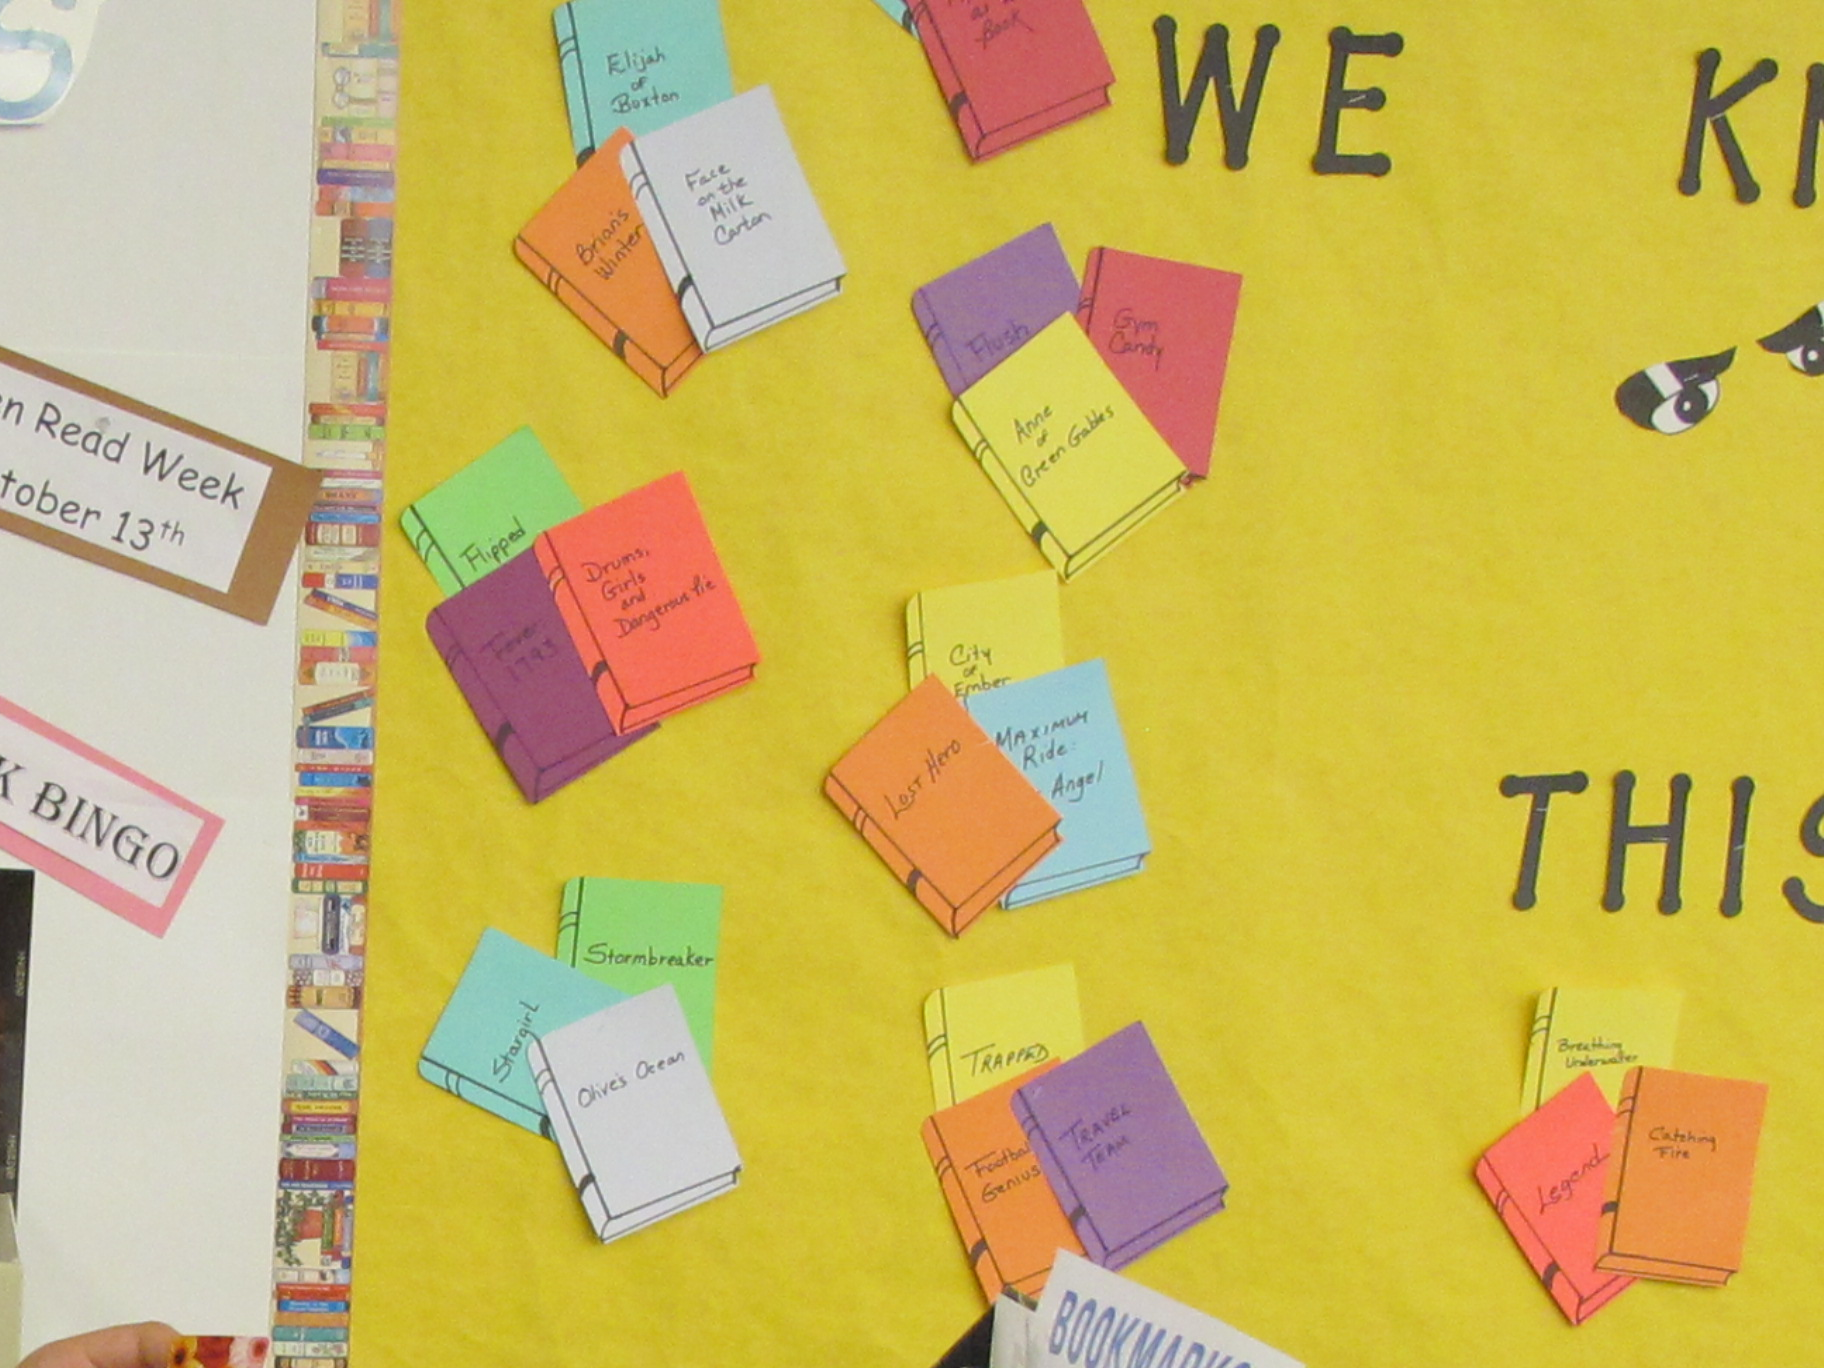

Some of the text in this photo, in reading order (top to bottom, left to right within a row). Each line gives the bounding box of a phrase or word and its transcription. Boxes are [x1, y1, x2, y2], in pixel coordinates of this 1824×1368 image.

[606, 46, 666, 76] Elijah
[630, 76, 647, 92] of
[1154, 15, 1404, 176] WE
[685, 164, 731, 191] Face
[697, 175, 747, 206] on the
[709, 195, 754, 221] Milk
[713, 211, 772, 246] Carton
[594, 223, 644, 280] Winter
[1113, 308, 1159, 336] Gym
[963, 317, 1031, 364] Flush
[1108, 330, 1163, 371] Candy
[1012, 405, 1054, 444] Anne
[34, 401, 132, 464] Read
[142, 441, 245, 510] Week
[1019, 446, 1066, 488] Green
[110, 510, 186, 552] 13th
[459, 517, 527, 573] Flipped
[601, 569, 646, 600] Girls
[621, 587, 645, 610] and
[950, 644, 992, 665] City
[954, 676, 1011, 699] Ember
[1051, 760, 1102, 803] Angel
[29, 781, 181, 880] BINGO
[583, 943, 714, 967] Stormbreaker
[492, 1000, 539, 1083] Stargirl
[1557, 1038, 1623, 1053] Breathing
[960, 1043, 1050, 1077] TRAPPED
[578, 1051, 685, 1107] Olive's Ocean
[1059, 1104, 1131, 1149] TRAVEL
[1649, 1127, 1716, 1152] Catching
[964, 1140, 1030, 1178] Footbal
[1081, 1136, 1129, 1172] TEAM
[1654, 1147, 1690, 1160] Fire
[1538, 1143, 1610, 1216] Legend
